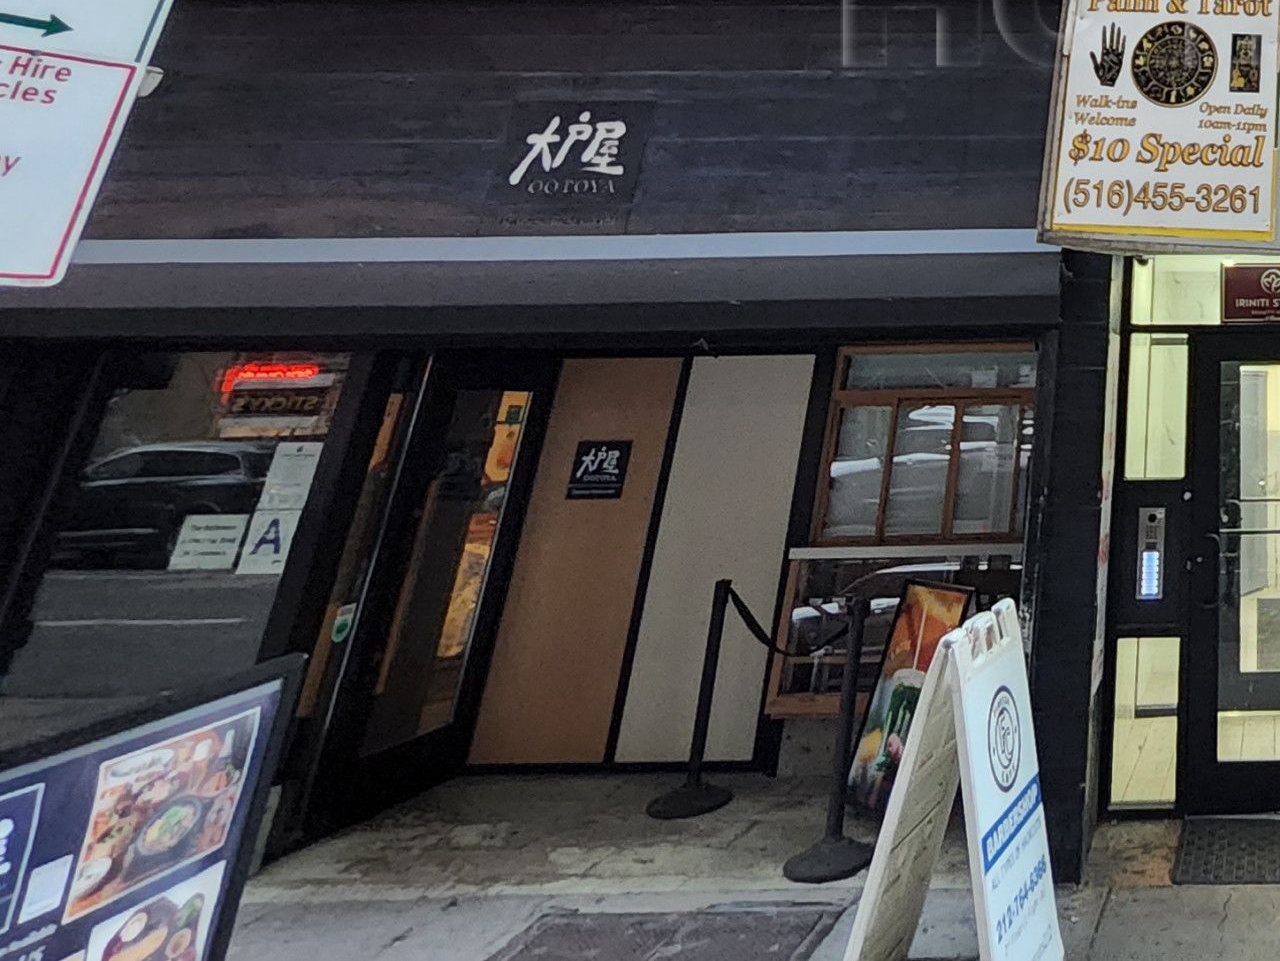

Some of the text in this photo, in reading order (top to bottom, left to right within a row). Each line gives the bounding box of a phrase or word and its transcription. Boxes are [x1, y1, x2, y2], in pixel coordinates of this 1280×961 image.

[8, 55, 72, 82] Hire
[1075, 94, 1137, 109] Walk-ins
[1199, 101, 1268, 119] Open Daily
[1073, 111, 1136, 127] Welcome
[1068, 129, 1266, 172] $10 Special
[1062, 176, 1261, 216] (516)455-3261
[248, 518, 281, 556] A
